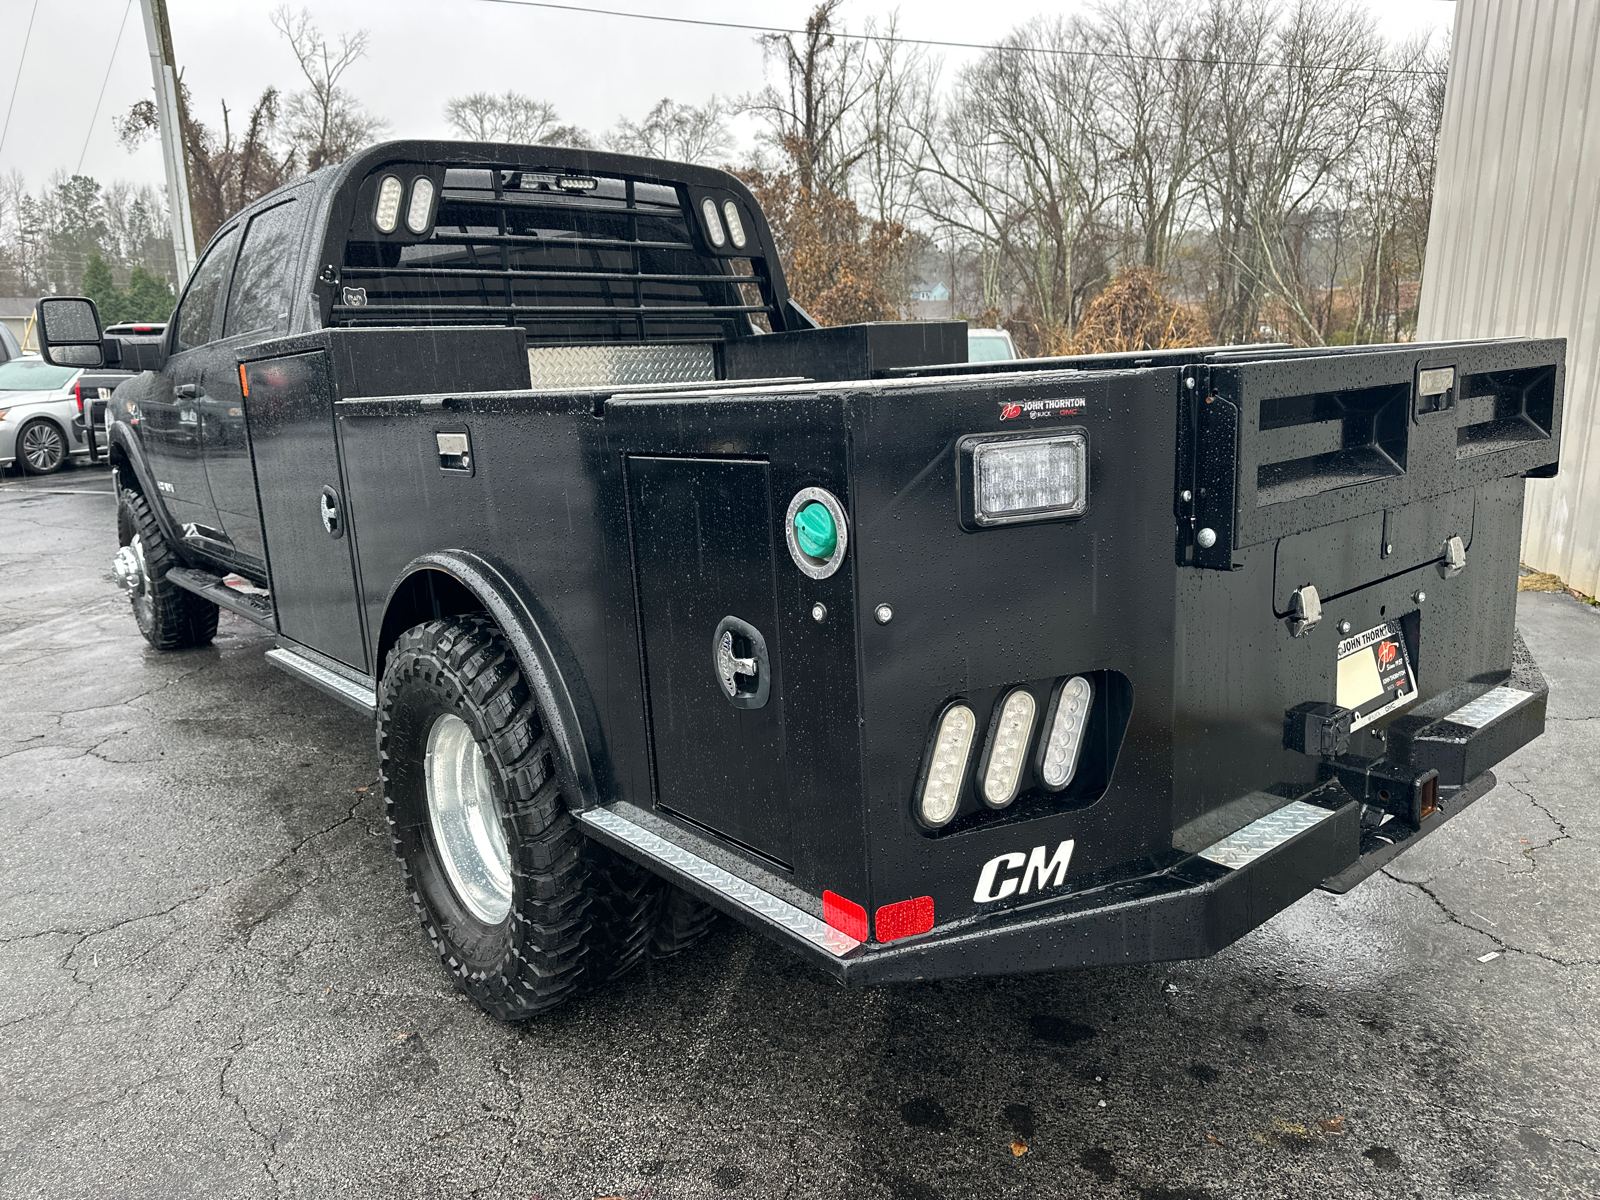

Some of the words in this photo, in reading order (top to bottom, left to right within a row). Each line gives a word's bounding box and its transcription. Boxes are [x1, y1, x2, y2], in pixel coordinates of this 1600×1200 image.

[1023, 401, 1044, 412] JOHN
[1045, 398, 1086, 409] THORNTON
[1343, 639, 1362, 653] JOHN
[973, 839, 1074, 903] CM
